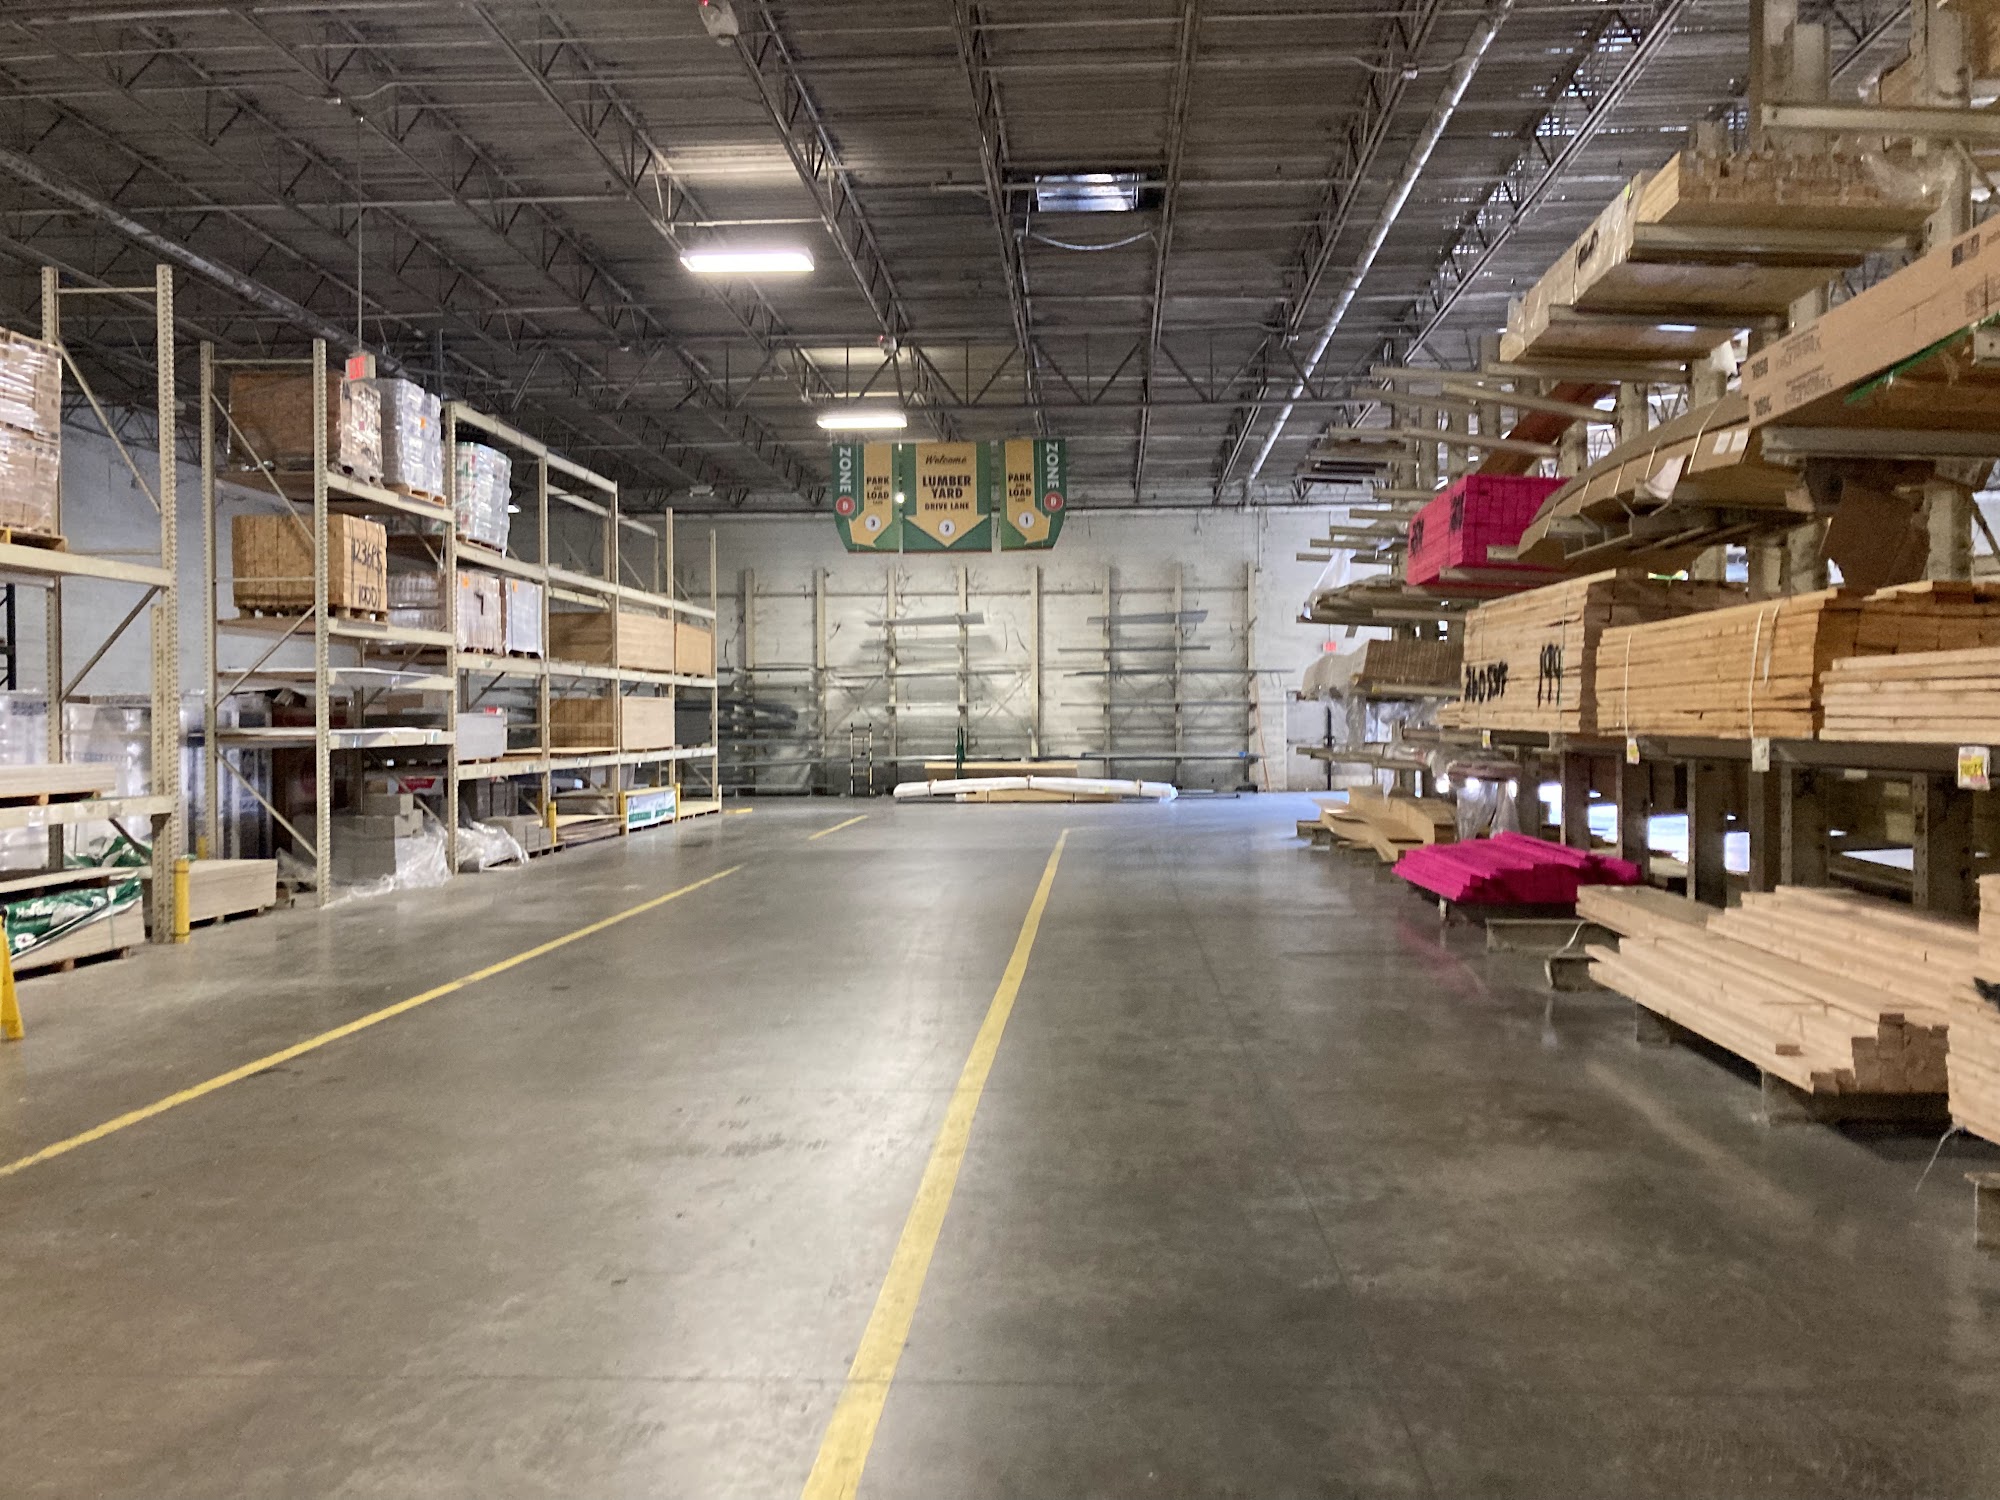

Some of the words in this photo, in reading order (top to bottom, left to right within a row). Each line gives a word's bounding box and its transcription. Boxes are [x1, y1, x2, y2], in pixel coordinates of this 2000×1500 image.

[926, 453, 967, 465] Welcome
[839, 447, 852, 493] ZONE
[1046, 442, 1060, 489] ZONE
[866, 476, 890, 485] PARK
[922, 475, 971, 487] LUMBER
[1008, 473, 1032, 482] PARK
[866, 491, 890, 500] LOAD
[931, 488, 963, 499] YARD
[1009, 488, 1032, 497] LOAD
[924, 503, 948, 511] DRIVE
[950, 502, 969, 510] LANE
